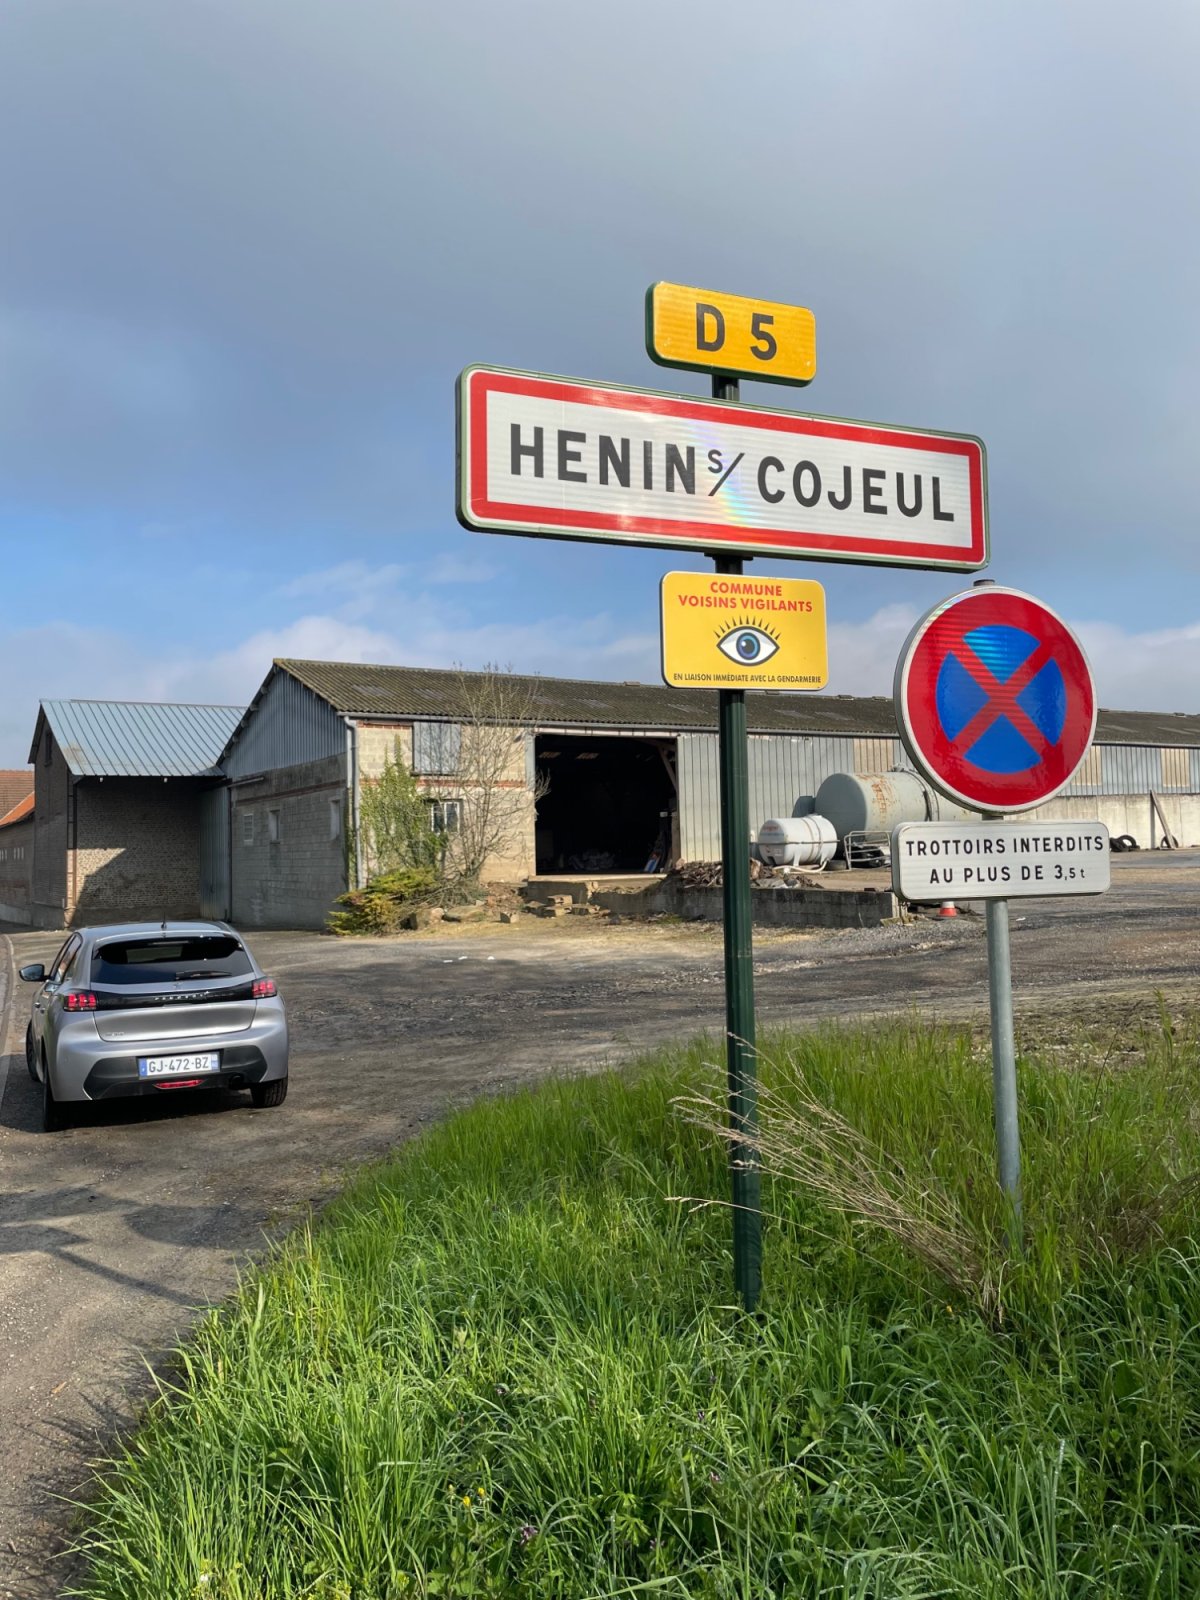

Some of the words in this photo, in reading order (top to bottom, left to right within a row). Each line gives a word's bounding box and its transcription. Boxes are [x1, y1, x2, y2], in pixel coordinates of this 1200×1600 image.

[696, 303, 726, 352] D
[749, 312, 778, 361] 5
[510, 423, 696, 495] HENIN
[757, 455, 955, 522] COJEUL
[710, 581, 782, 596] COMMUNE
[678, 595, 737, 609] VOISINS
[740, 598, 813, 612] VIGILANTS
[673, 673, 683, 681] EN
[684, 673, 712, 682] LIAISON
[750, 674, 766, 682] AVEC
[767, 675, 776, 683] LA
[777, 675, 822, 683] GENDARMERIE
[905, 838, 1006, 856] TROTTOIRS
[1013, 835, 1104, 853] INTERDITS
[929, 868, 954, 884] AU
[963, 866, 1011, 883] PLUS
[1021, 865, 1044, 881] DE
[149, 1056, 209, 1073] GJ-472-BZ
